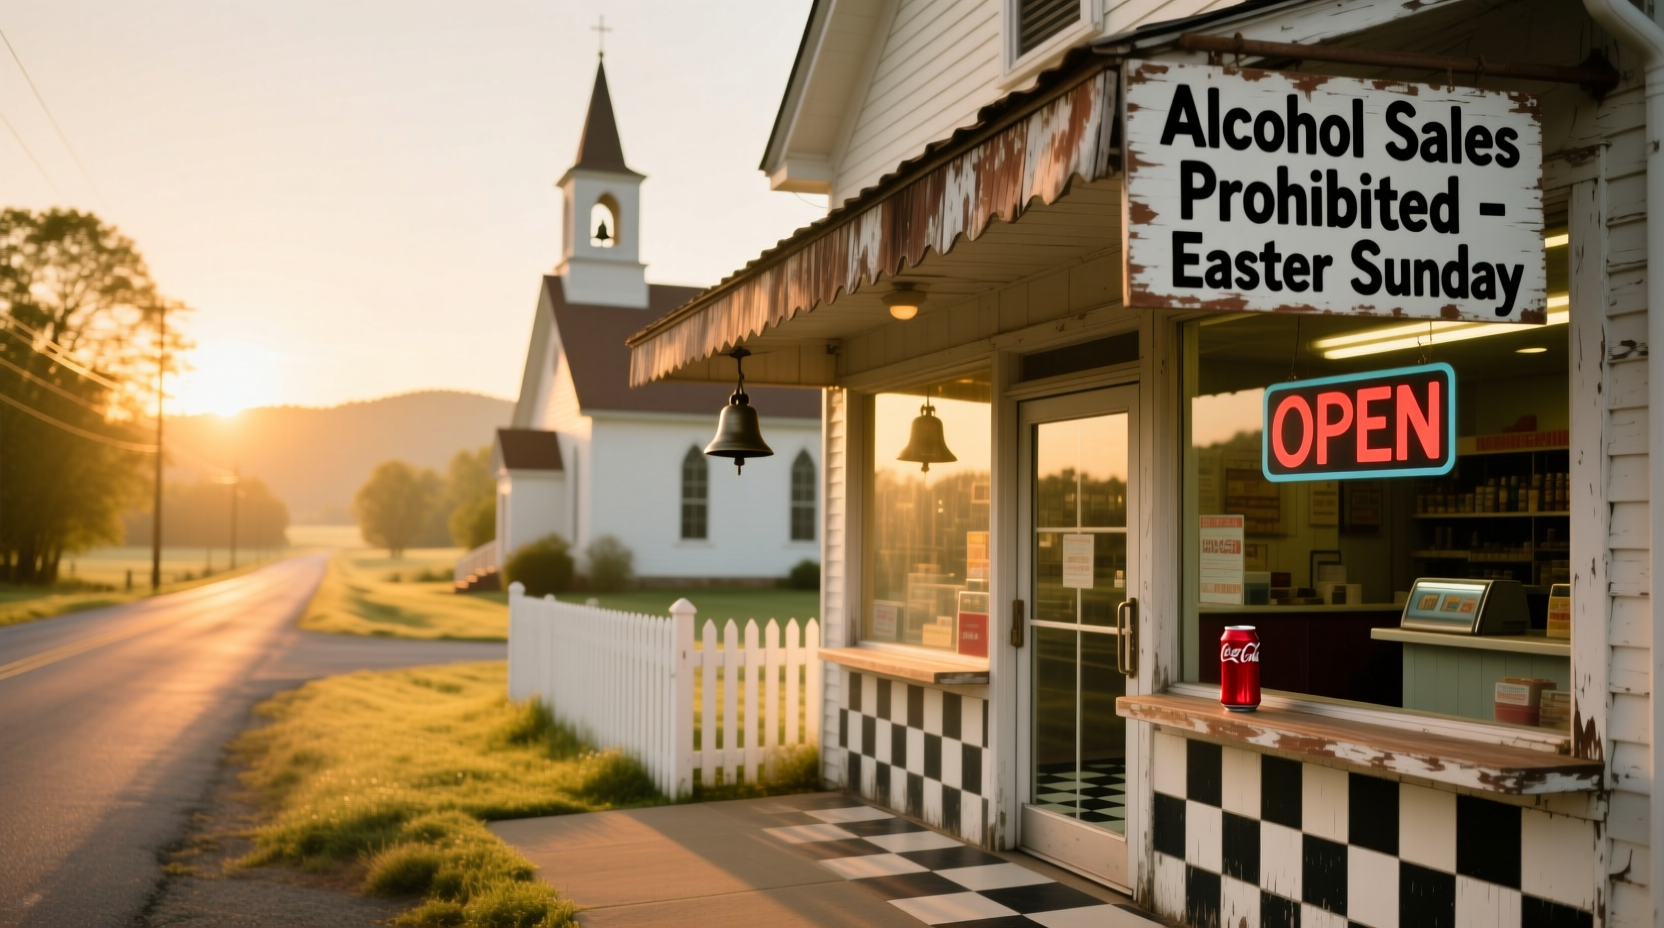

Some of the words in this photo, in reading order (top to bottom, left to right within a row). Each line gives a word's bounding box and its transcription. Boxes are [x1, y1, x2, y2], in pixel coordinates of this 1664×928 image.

[1160, 84, 1364, 158] Alcohol
[1385, 101, 1520, 168] Sales
[1180, 160, 1460, 234] Prohibited
[1480, 204, 1505, 216] -
[1172, 231, 1333, 292] Easter
[1351, 240, 1524, 316] Sunday
[1272, 381, 1440, 468] OPEN
